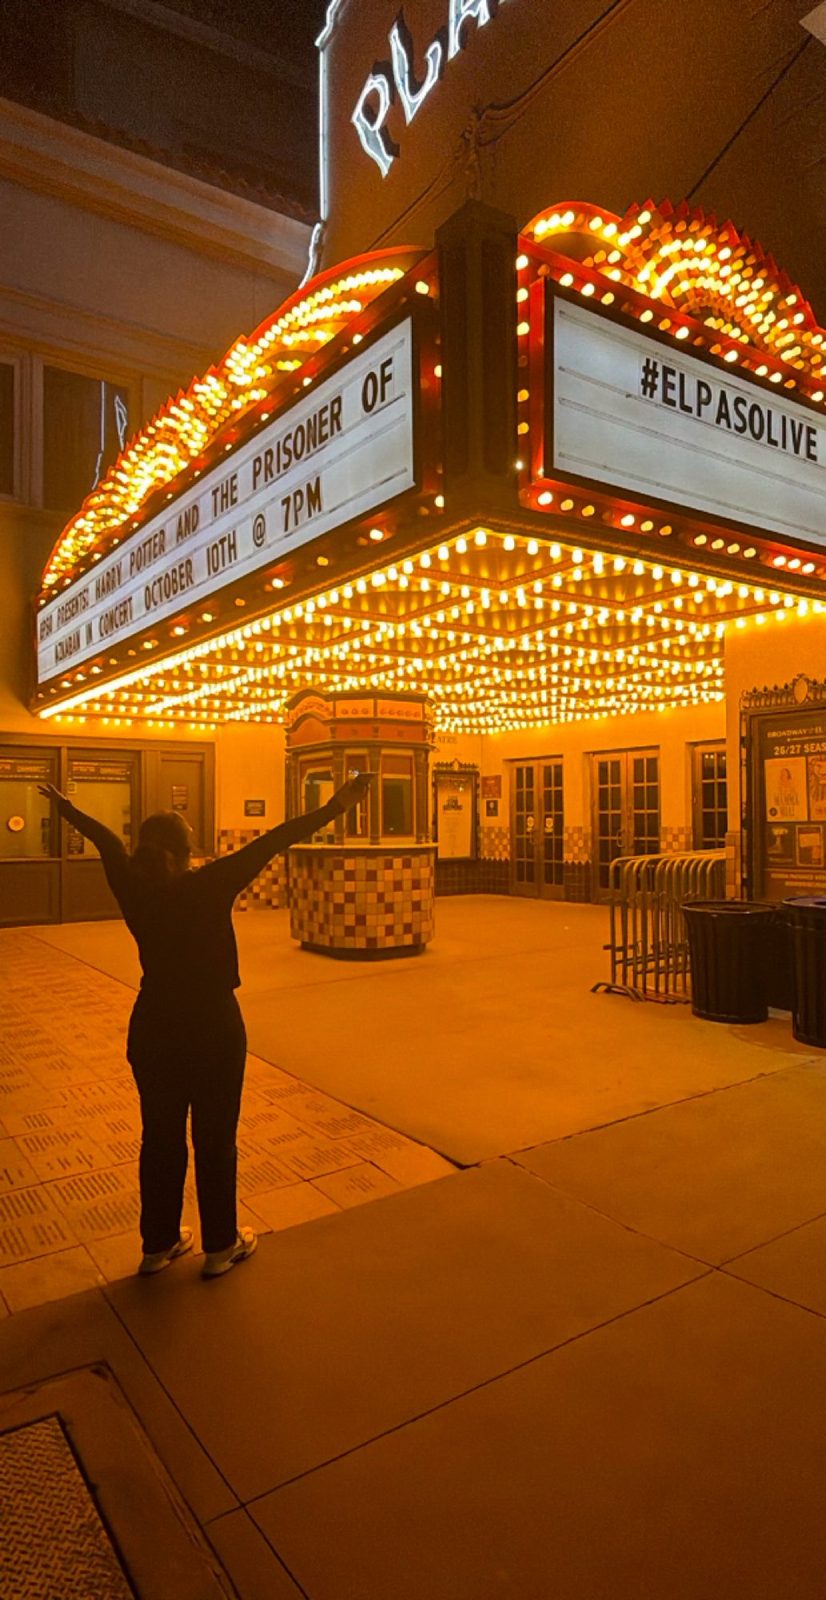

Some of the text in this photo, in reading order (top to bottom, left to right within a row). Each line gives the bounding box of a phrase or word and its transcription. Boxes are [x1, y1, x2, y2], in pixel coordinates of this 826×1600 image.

[351, 0, 490, 178] PLA
[95, 561, 122, 600] HARRY
[129, 530, 165, 576] POTTER
[176, 504, 199, 541] AND
[212, 474, 238, 517] THE
[252, 396, 341, 489] PRISONER
[361, 357, 393, 413] OF
[641, 357, 817, 462] #ELPASOLIVE
[99, 596, 133, 637] CONCERT
[144, 559, 193, 611] OCTOBER
[252, 513, 266, 548] @
[281, 476, 322, 532] 7PM
